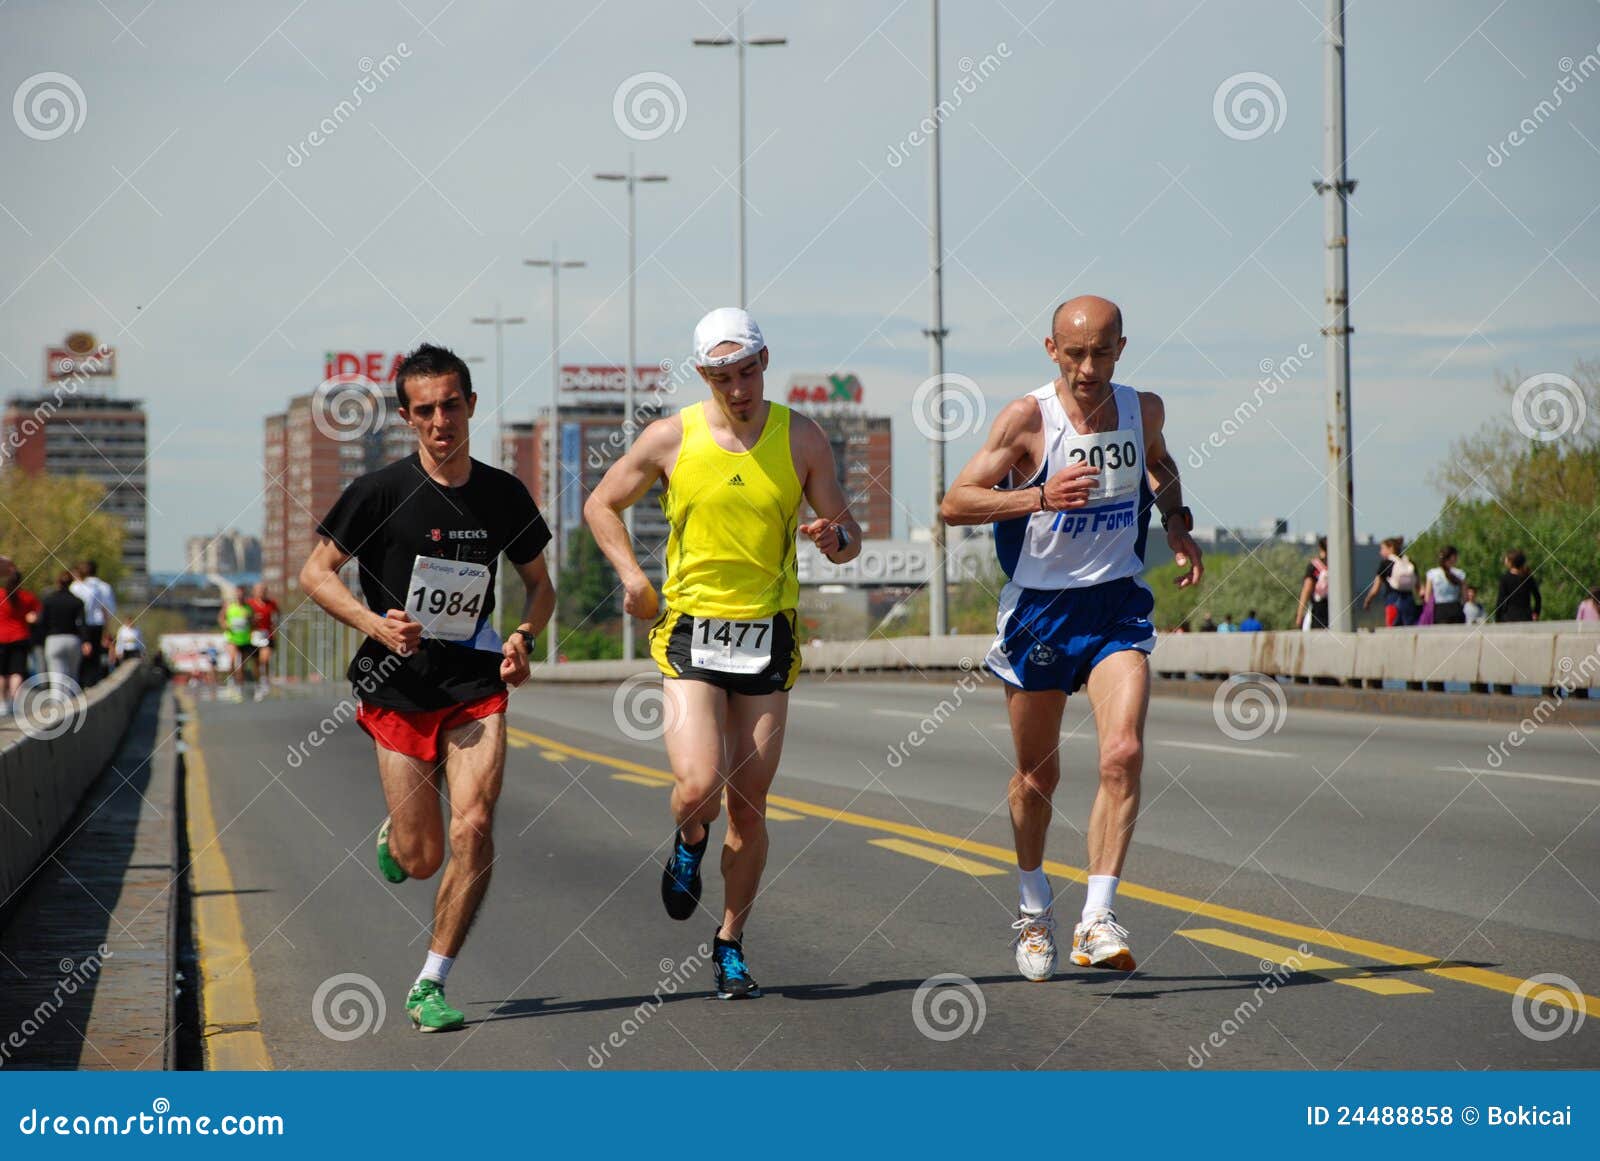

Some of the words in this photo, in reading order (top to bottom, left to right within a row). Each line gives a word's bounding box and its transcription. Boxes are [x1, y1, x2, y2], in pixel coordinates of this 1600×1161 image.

[1069, 441, 1136, 470] 2030
[1092, 509, 1136, 533] Form
[413, 586, 481, 618] 1984
[698, 618, 770, 648] 1477
